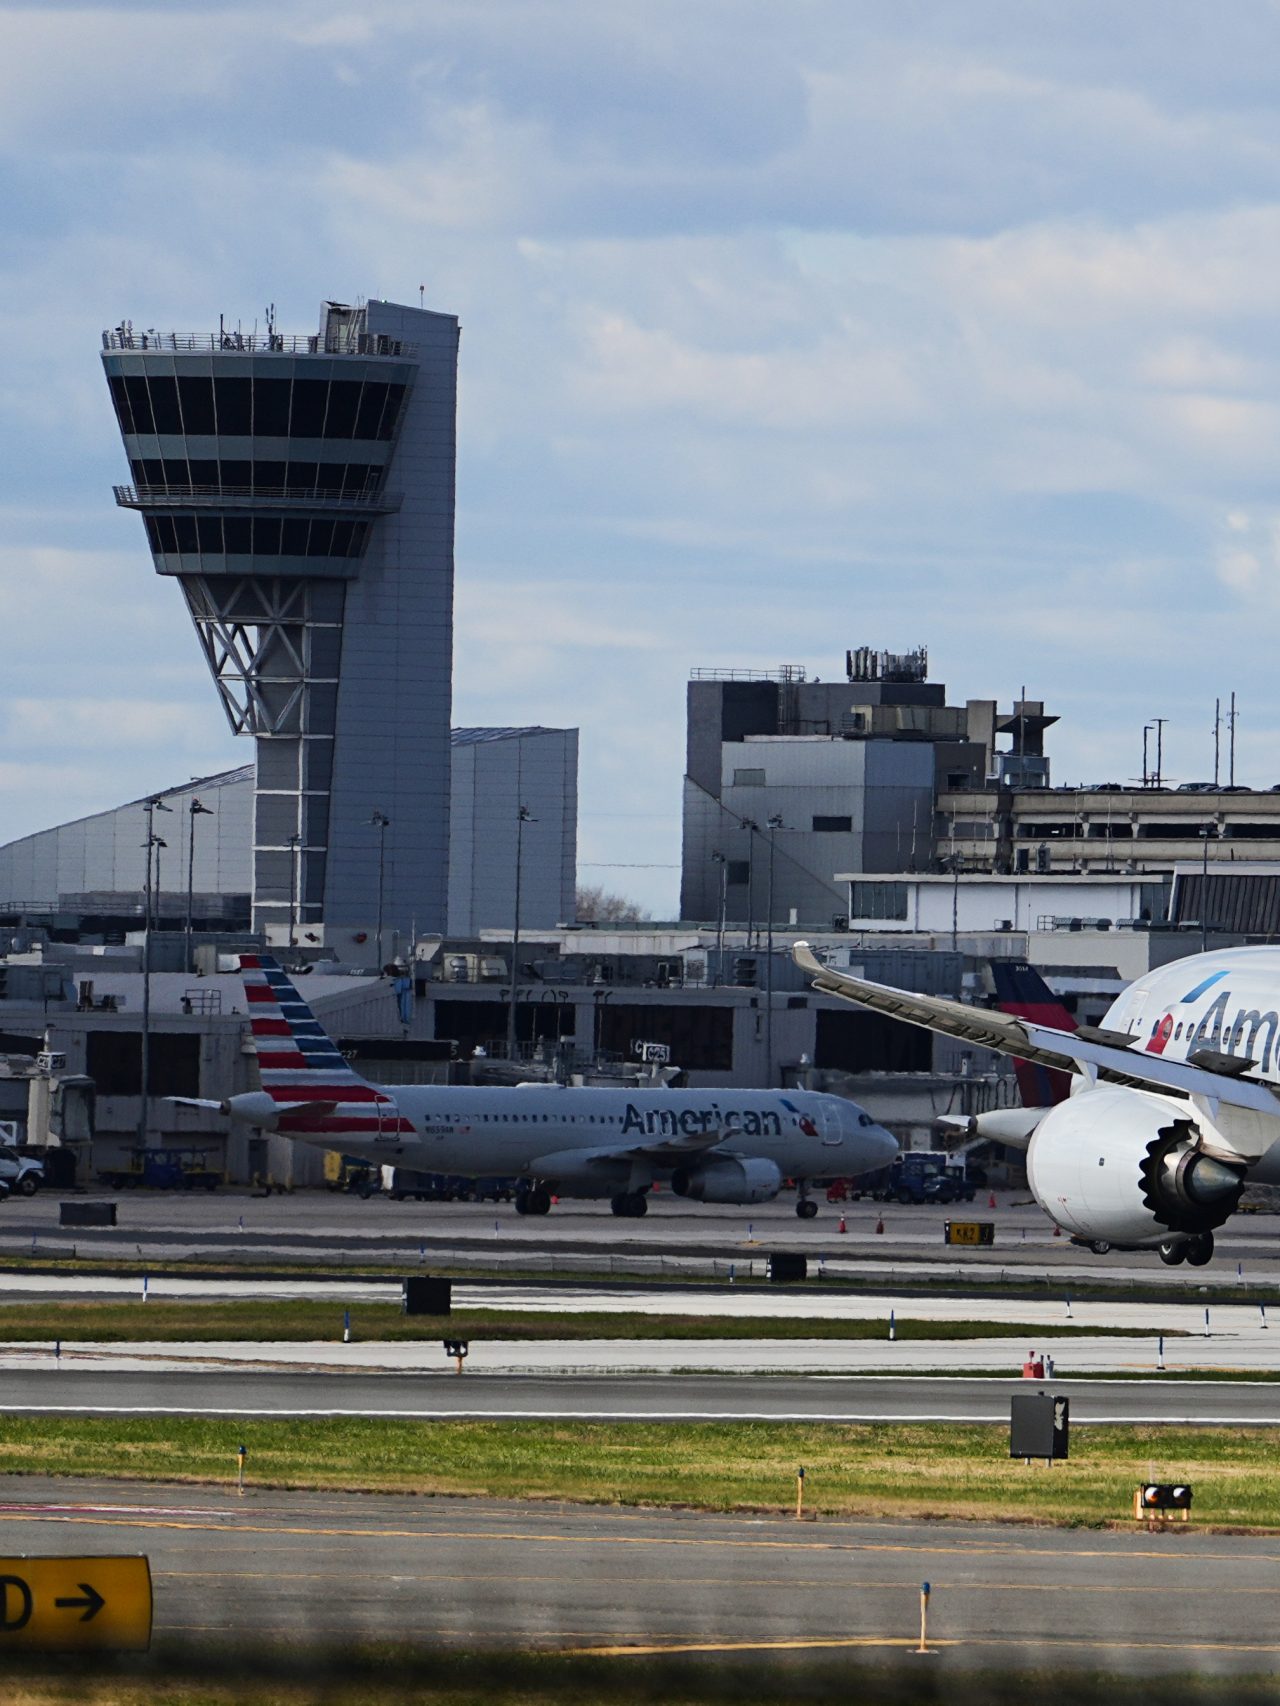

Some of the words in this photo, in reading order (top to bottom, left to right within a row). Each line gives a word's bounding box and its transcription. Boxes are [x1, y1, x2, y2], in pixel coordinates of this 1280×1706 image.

[648, 1046, 665, 1061] C25
[621, 1103, 782, 1136] American
[0, 1575, 33, 1631] D
